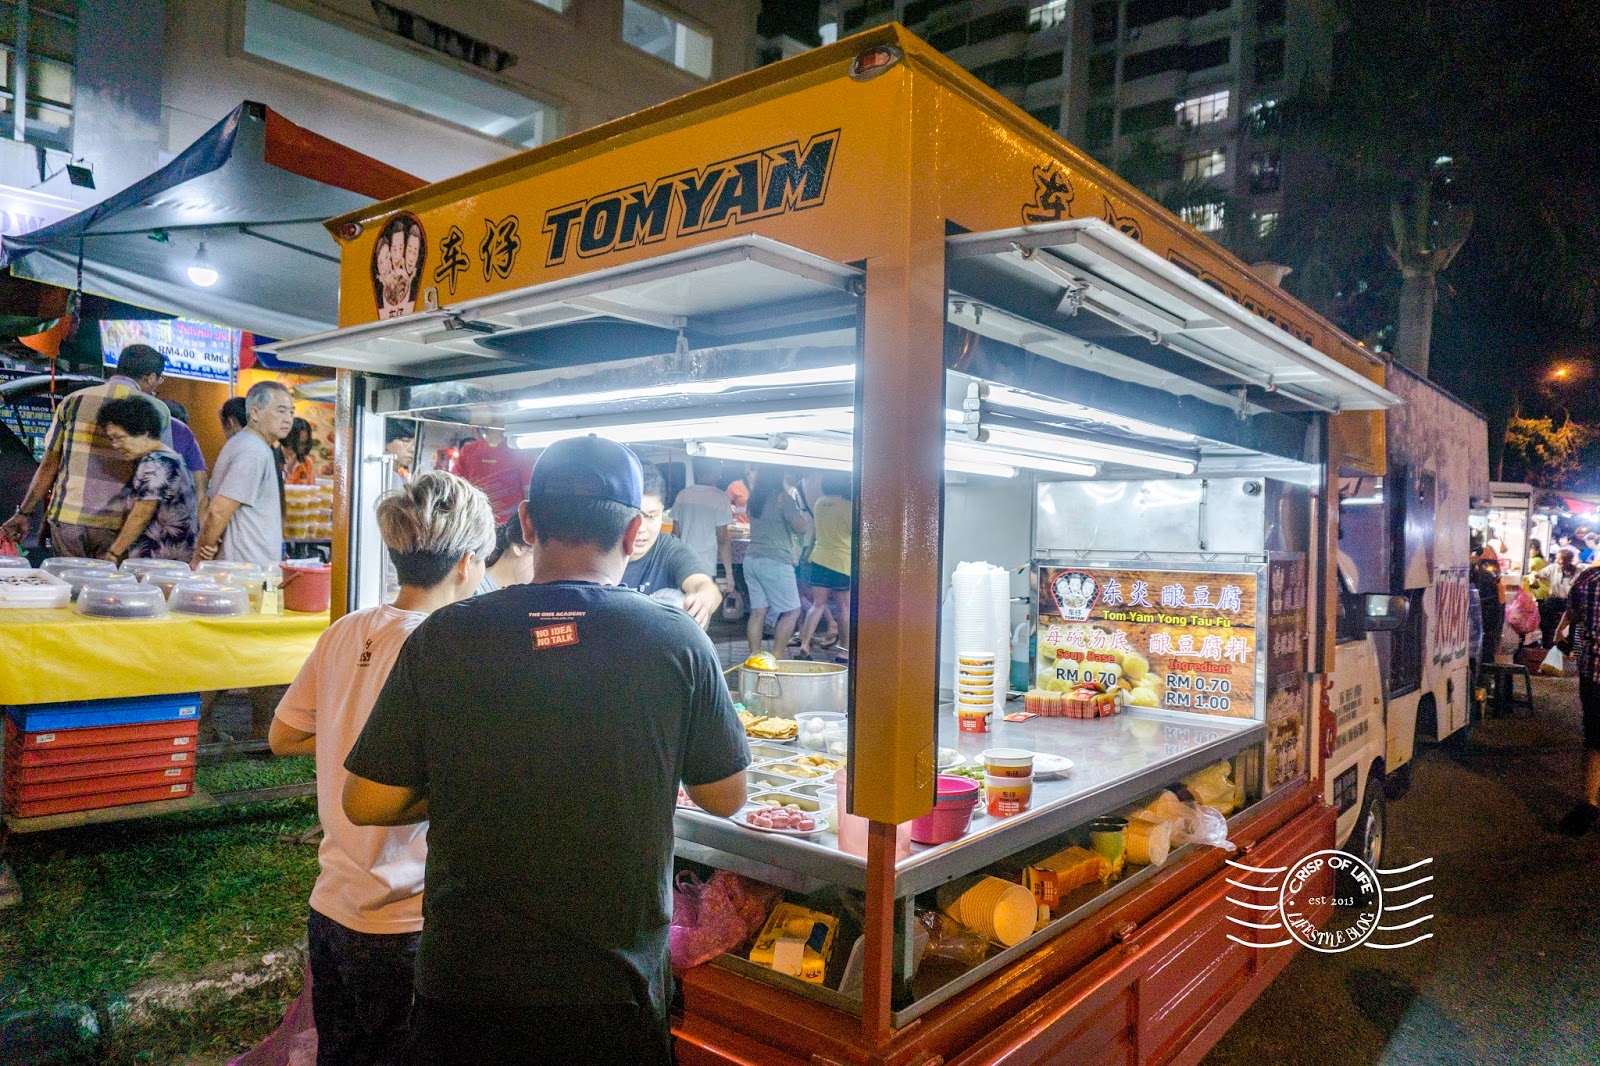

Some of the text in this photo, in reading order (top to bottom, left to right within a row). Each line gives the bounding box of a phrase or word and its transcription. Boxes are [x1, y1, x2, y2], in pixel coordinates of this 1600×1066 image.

[541, 128, 842, 267] TOMYAM
[434, 214, 521, 295] 车仔
[158, 345, 195, 359] RM4.00
[1102, 610, 1231, 628] Tom Yam Yong Tau Fu
[535, 625, 573, 639] NO IDEA
[537, 633, 574, 646] NO TALK
[1044, 625, 1131, 653] 每碗汤底
[1056, 649, 1116, 663] Soup Base
[1149, 632, 1253, 664] 酿豆腐料
[1168, 659, 1232, 674] Ingredient
[1056, 668, 1117, 686] RM 0.70
[1166, 674, 1230, 693] RM 0.70
[1166, 692, 1230, 711] RM 1.00
